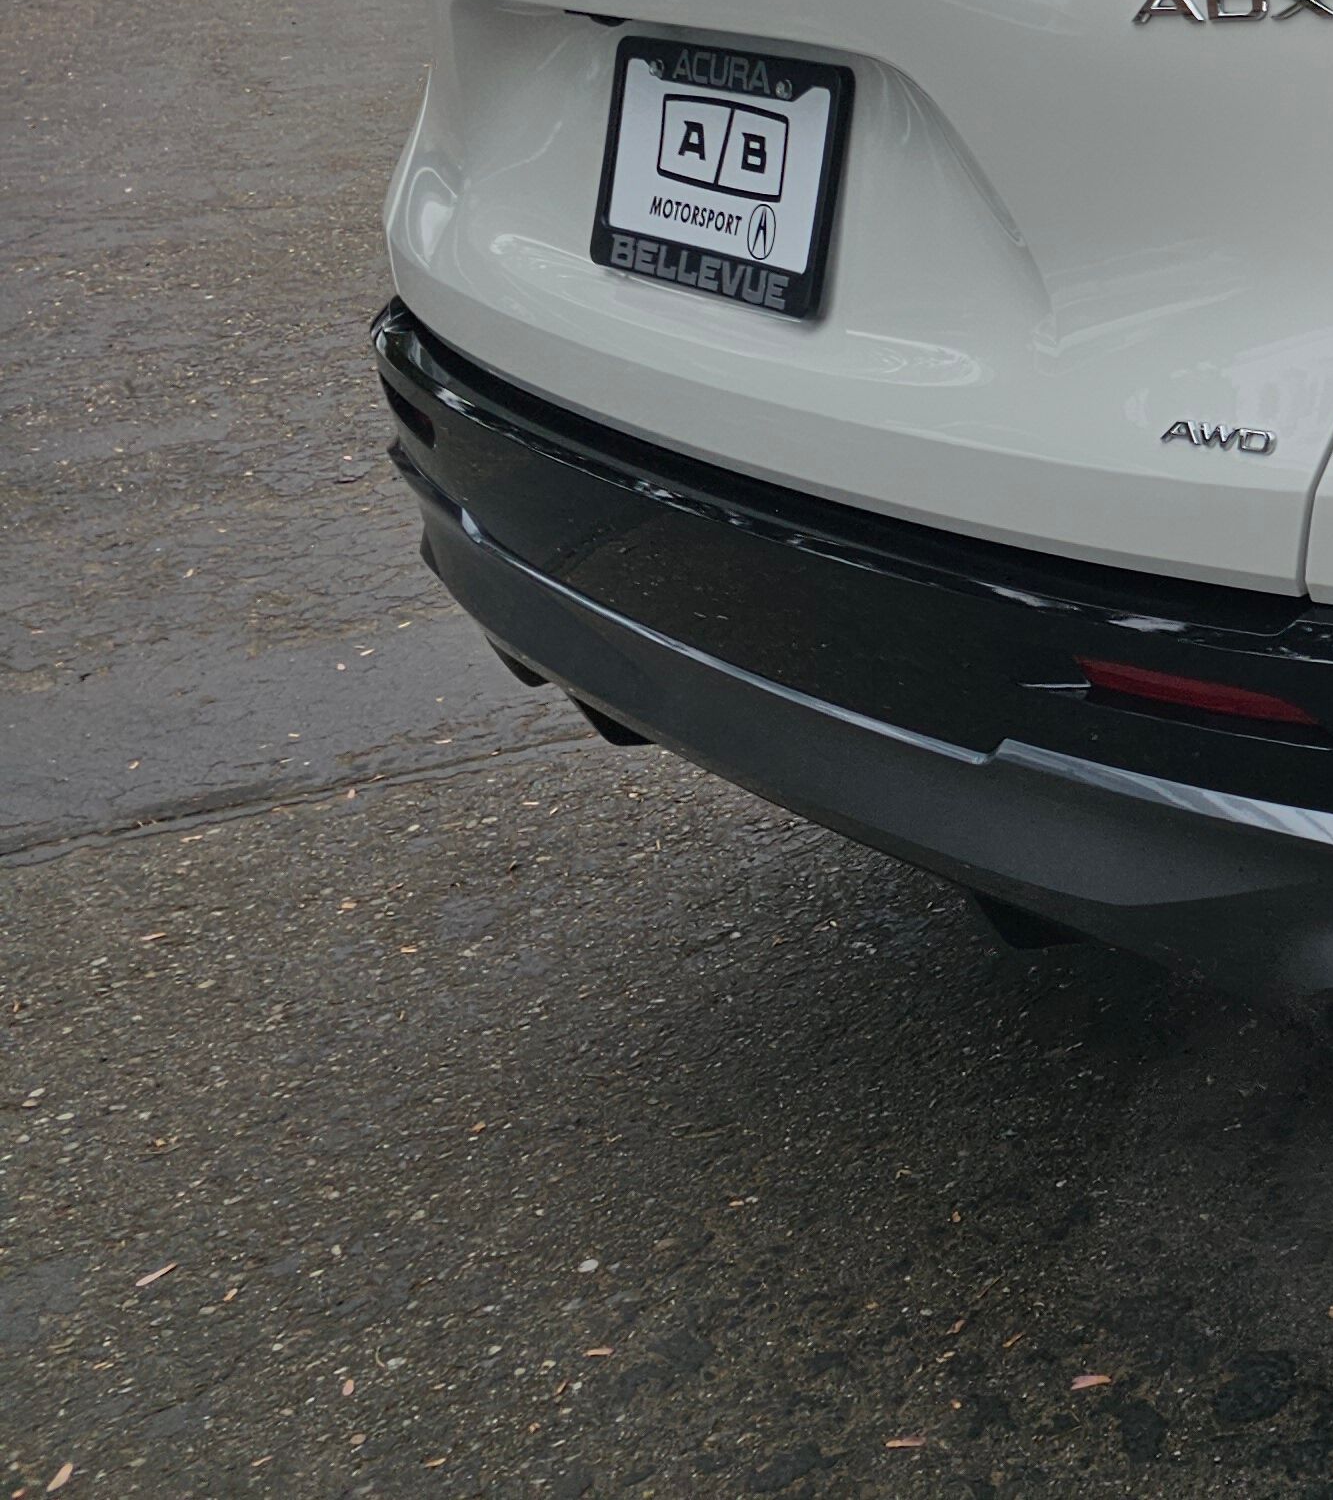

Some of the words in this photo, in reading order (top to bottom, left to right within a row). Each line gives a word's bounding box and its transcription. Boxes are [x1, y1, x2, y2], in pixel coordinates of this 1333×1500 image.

[672, 49, 771, 95] ACURA
[678, 120, 706, 161] A
[741, 131, 767, 174] B
[649, 195, 742, 237] MOTORSPORT
[609, 233, 790, 310] BELLEVUE
[1160, 419, 1278, 456] AWD
